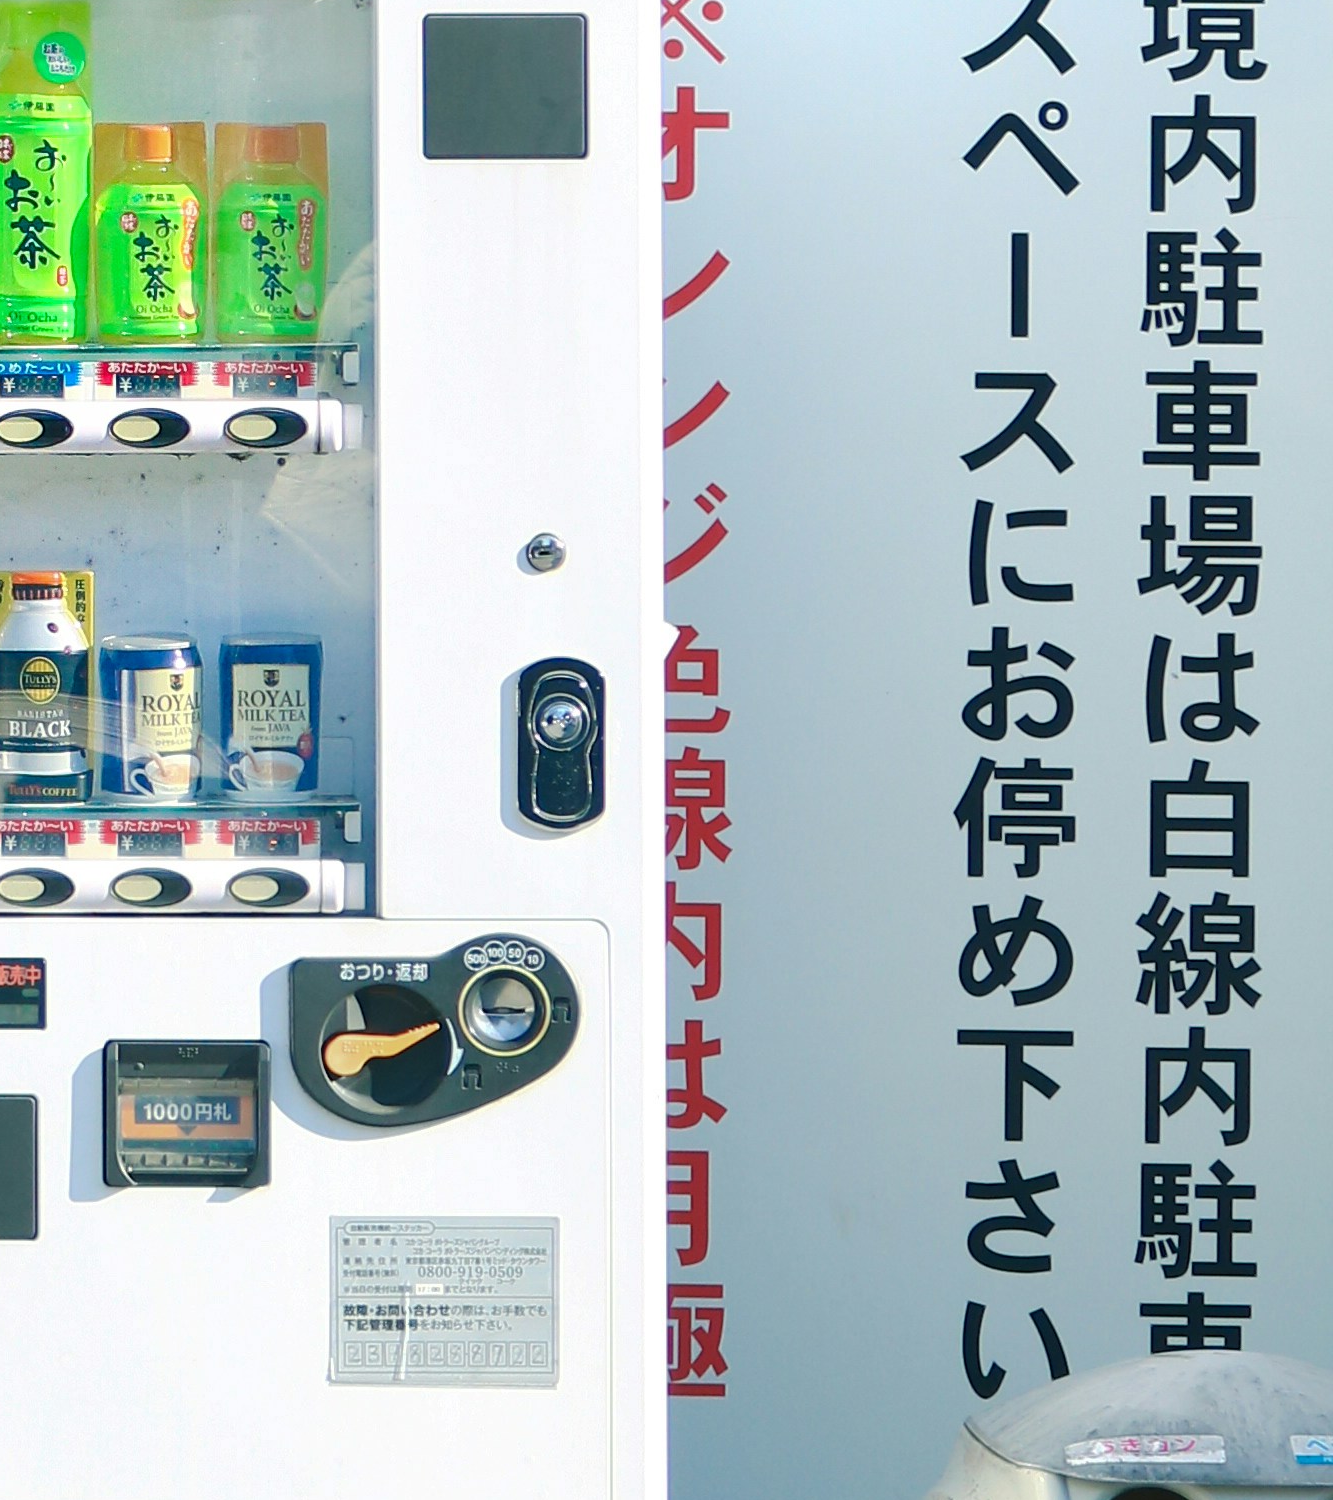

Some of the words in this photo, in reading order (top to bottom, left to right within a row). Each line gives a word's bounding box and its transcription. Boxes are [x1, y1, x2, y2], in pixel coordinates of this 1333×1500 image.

[4, 169, 61, 270] お茶
[133, 231, 175, 301] お茶
[252, 230, 293, 300] お茶
[75, 579, 86, 623] 圧倒的な
[142, 692, 200, 712] ROYAL
[237, 690, 306, 707] ROYAL
[142, 713, 181, 727] MILK
[237, 709, 277, 722] MILK
[281, 709, 306, 722] TEA
[9, 720, 71, 737] BLACK
[467, 953, 485, 964] 500
[487, 948, 504, 958] 100
[508, 948, 521, 958] 50
[527, 955, 539, 965] 10
[340, 963, 428, 981] おつり・返却
[143, 1102, 232, 1121] 1000円札
[418, 1266, 523, 1278] 0800-919-0509
[343, 1319, 512, 1331] 下記管理番号をお知らせ下さい。
